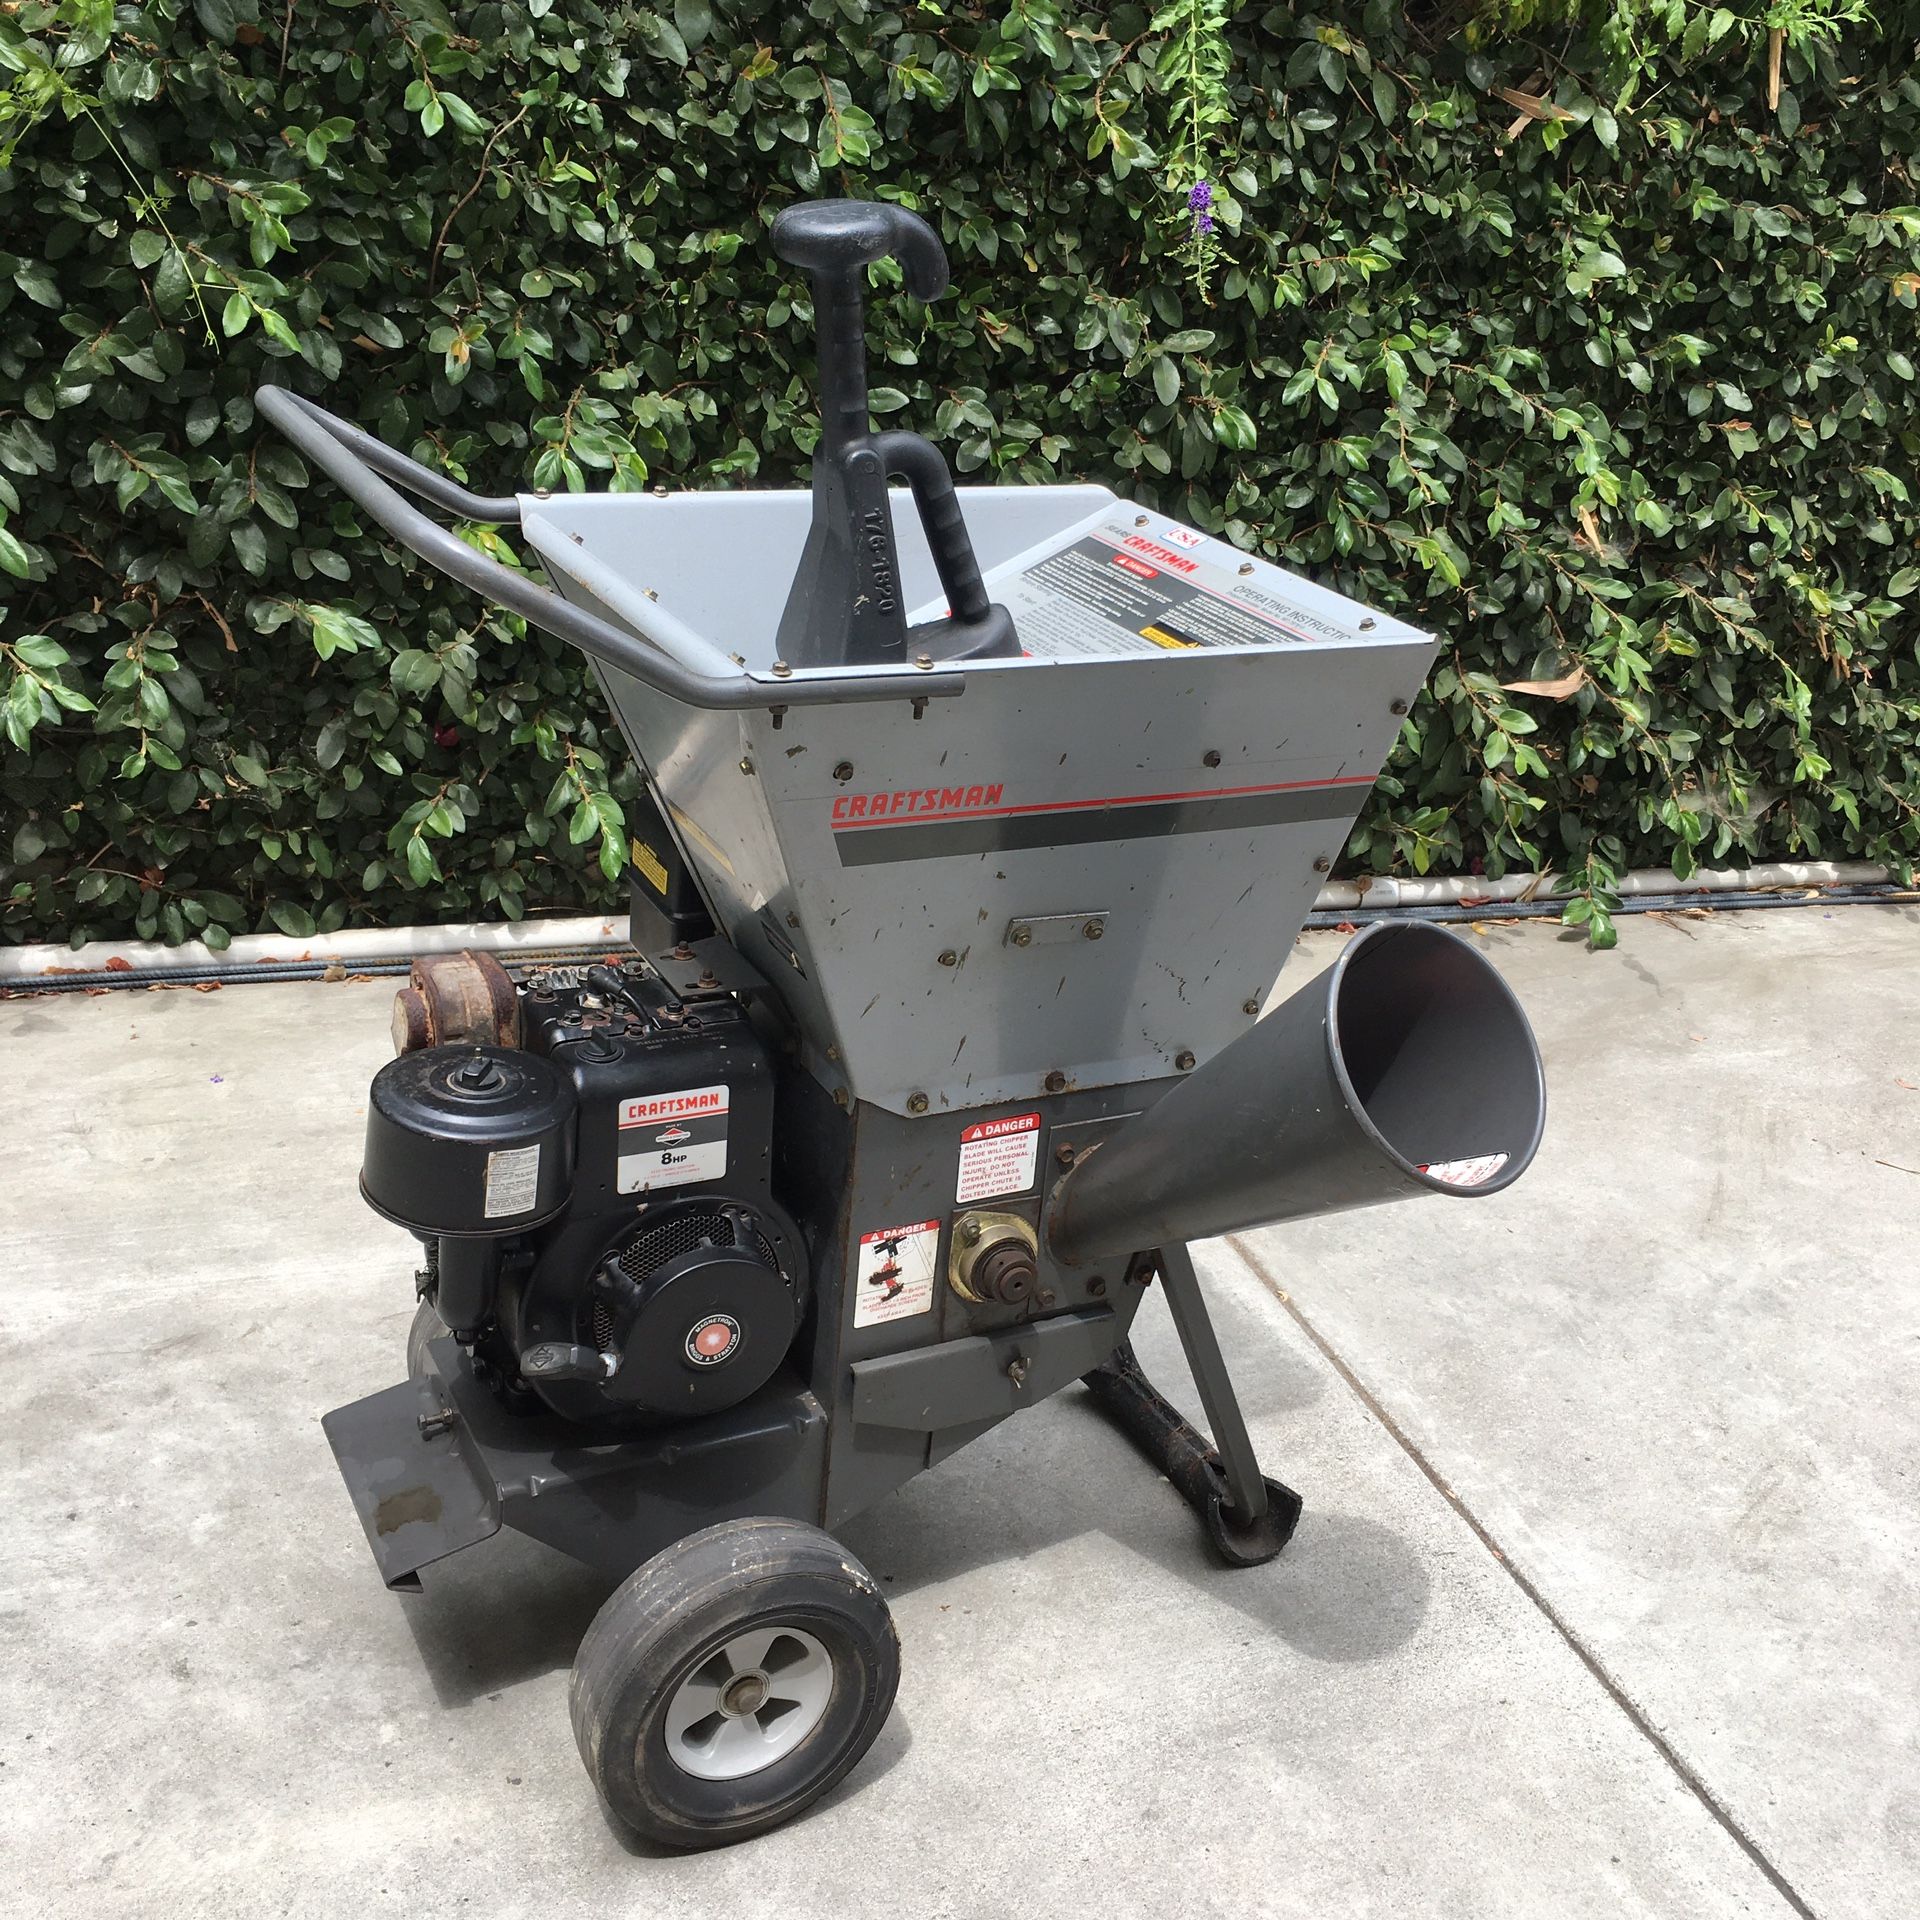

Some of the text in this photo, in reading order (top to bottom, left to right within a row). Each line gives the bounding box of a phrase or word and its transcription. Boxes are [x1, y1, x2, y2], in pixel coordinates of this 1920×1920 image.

[1168, 529, 1201, 546] USA
[1122, 535, 1200, 573] CRAFTSMAN
[1233, 585, 1291, 614] OPERATING
[832, 783, 1003, 819] CRAFTSMAN
[628, 1093, 720, 1119] CRAFTSMAN
[985, 1118, 1034, 1136] DANGER
[964, 1135, 1029, 1152] ROTATING CHIPPER
[964, 1143, 1027, 1160] BLADE WILL CAUSE
[963, 1157, 992, 1168] SERIOUS
[994, 1151, 1029, 1162] PERSONAL
[961, 1181, 990, 1192] CHIPPER
[991, 1177, 1013, 1186] CHUTE
[962, 1168, 1020, 1184] OPERATE UNLESS
[960, 1191, 986, 1200] BOLTED
[883, 1223, 927, 1239] DANGER
[713, 1333, 738, 1360] STRATTON
